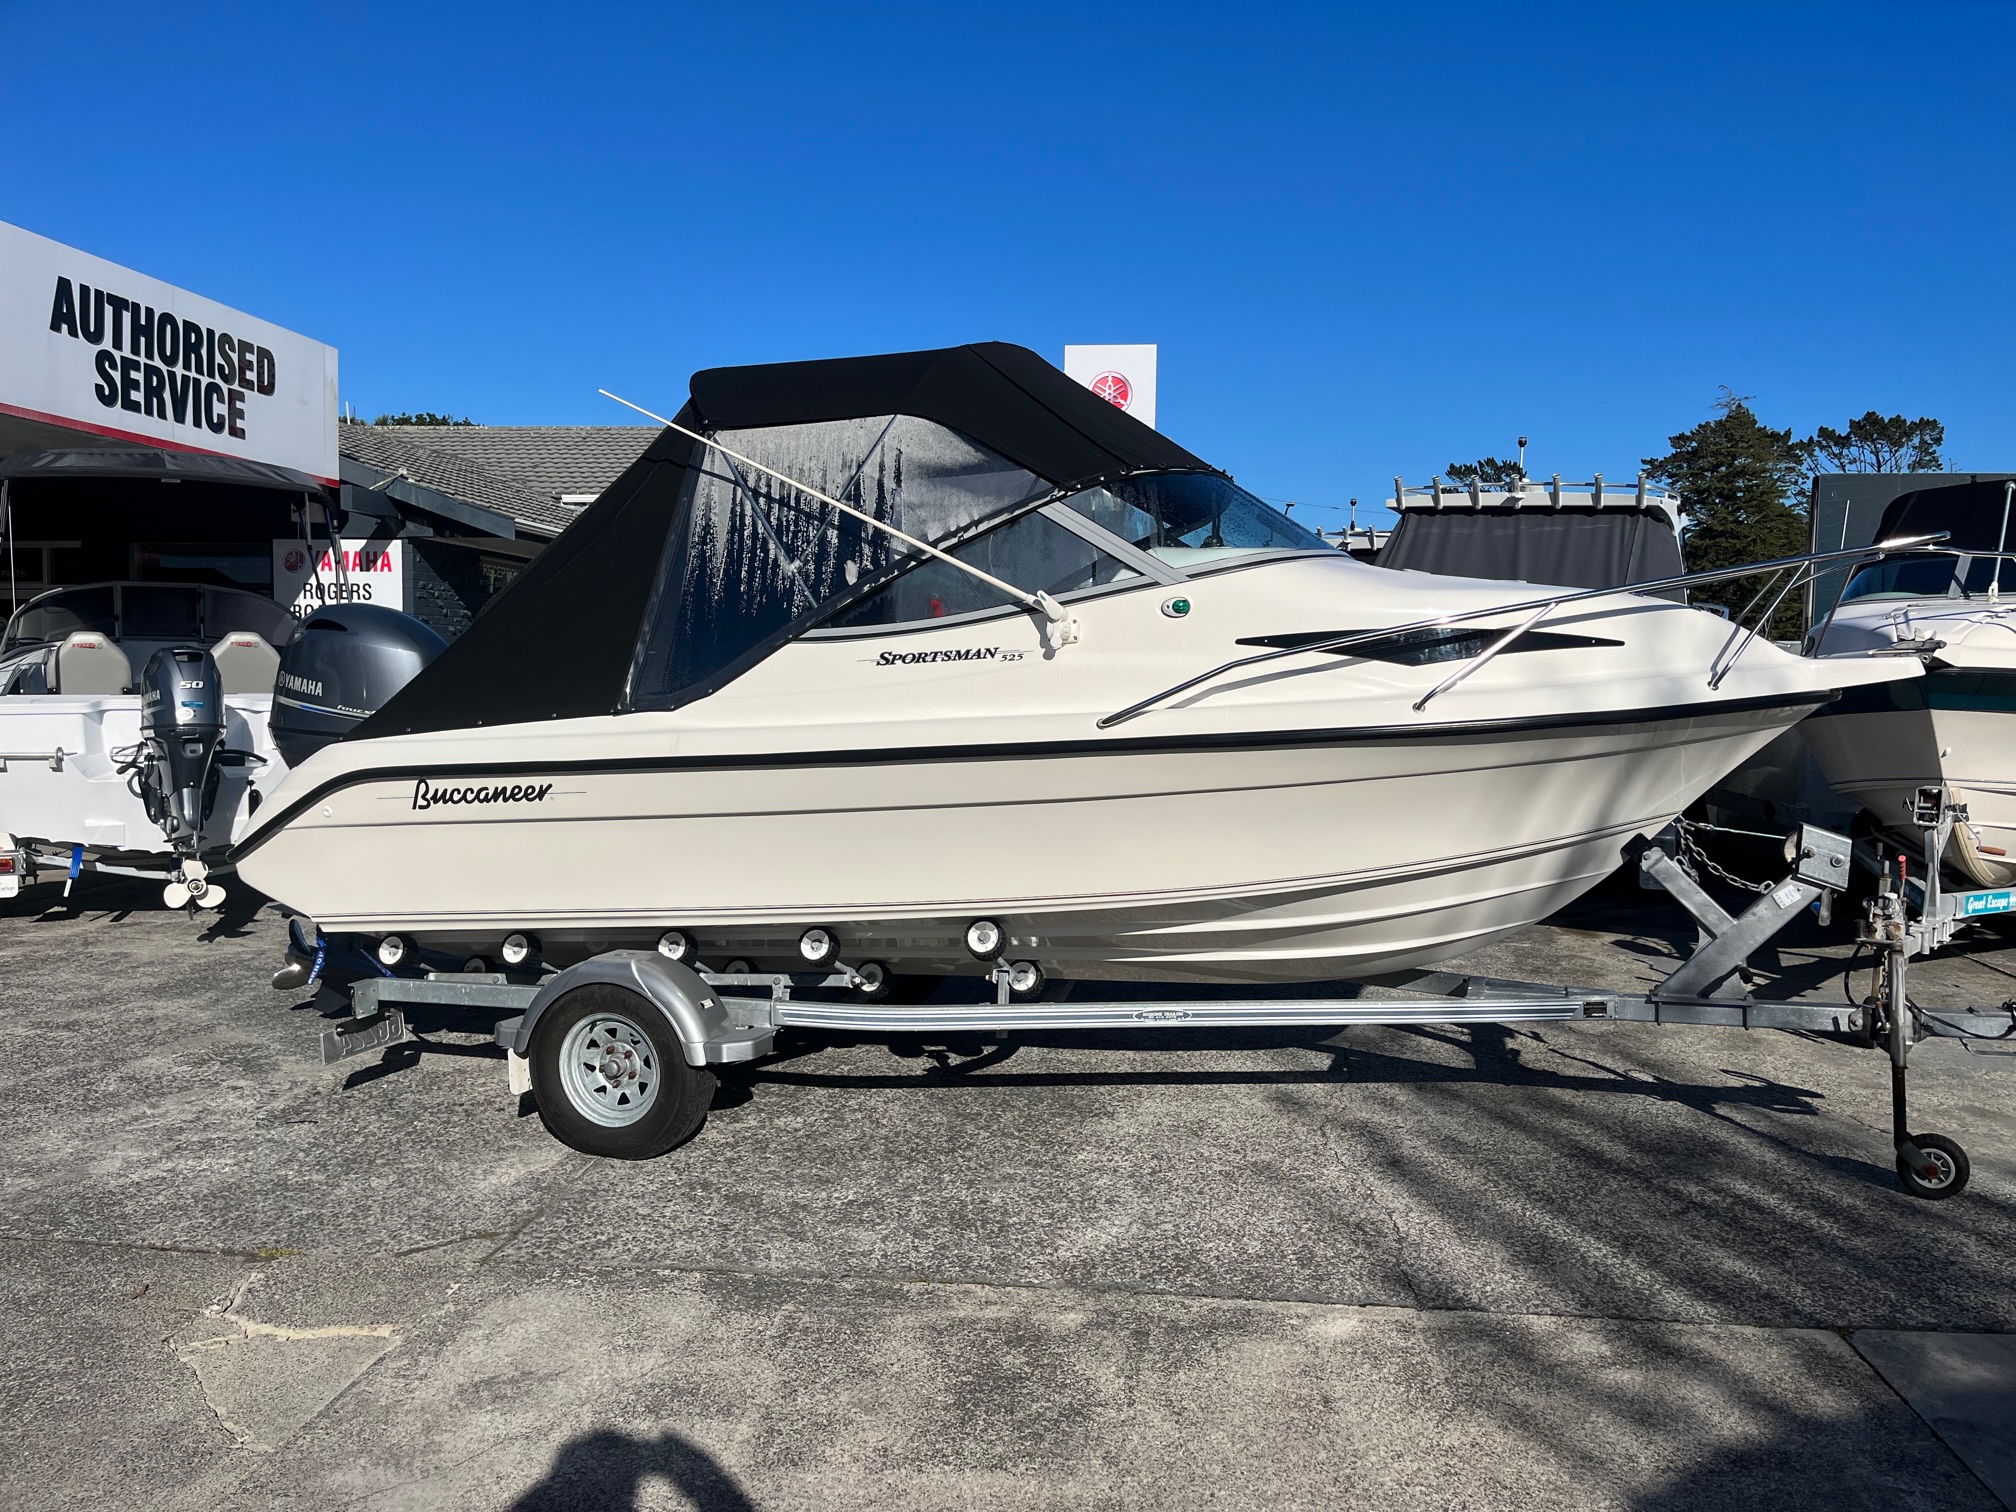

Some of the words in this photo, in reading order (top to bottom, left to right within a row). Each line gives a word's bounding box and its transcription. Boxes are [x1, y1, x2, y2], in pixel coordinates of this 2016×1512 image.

[50, 276, 275, 396] AUTHORISED
[94, 349, 246, 440] SERVICE
[1, 569, 26, 578] PATS
[303, 582, 372, 600] ROGERS
[876, 647, 1000, 666] SPORTSMAN
[1000, 653, 1024, 662] 525
[180, 681, 204, 689] 50
[285, 673, 322, 697] YAMAHA
[412, 779, 553, 810] Buccaneer
[1968, 897, 1987, 914] Great
[1987, 895, 2009, 910] Escape
